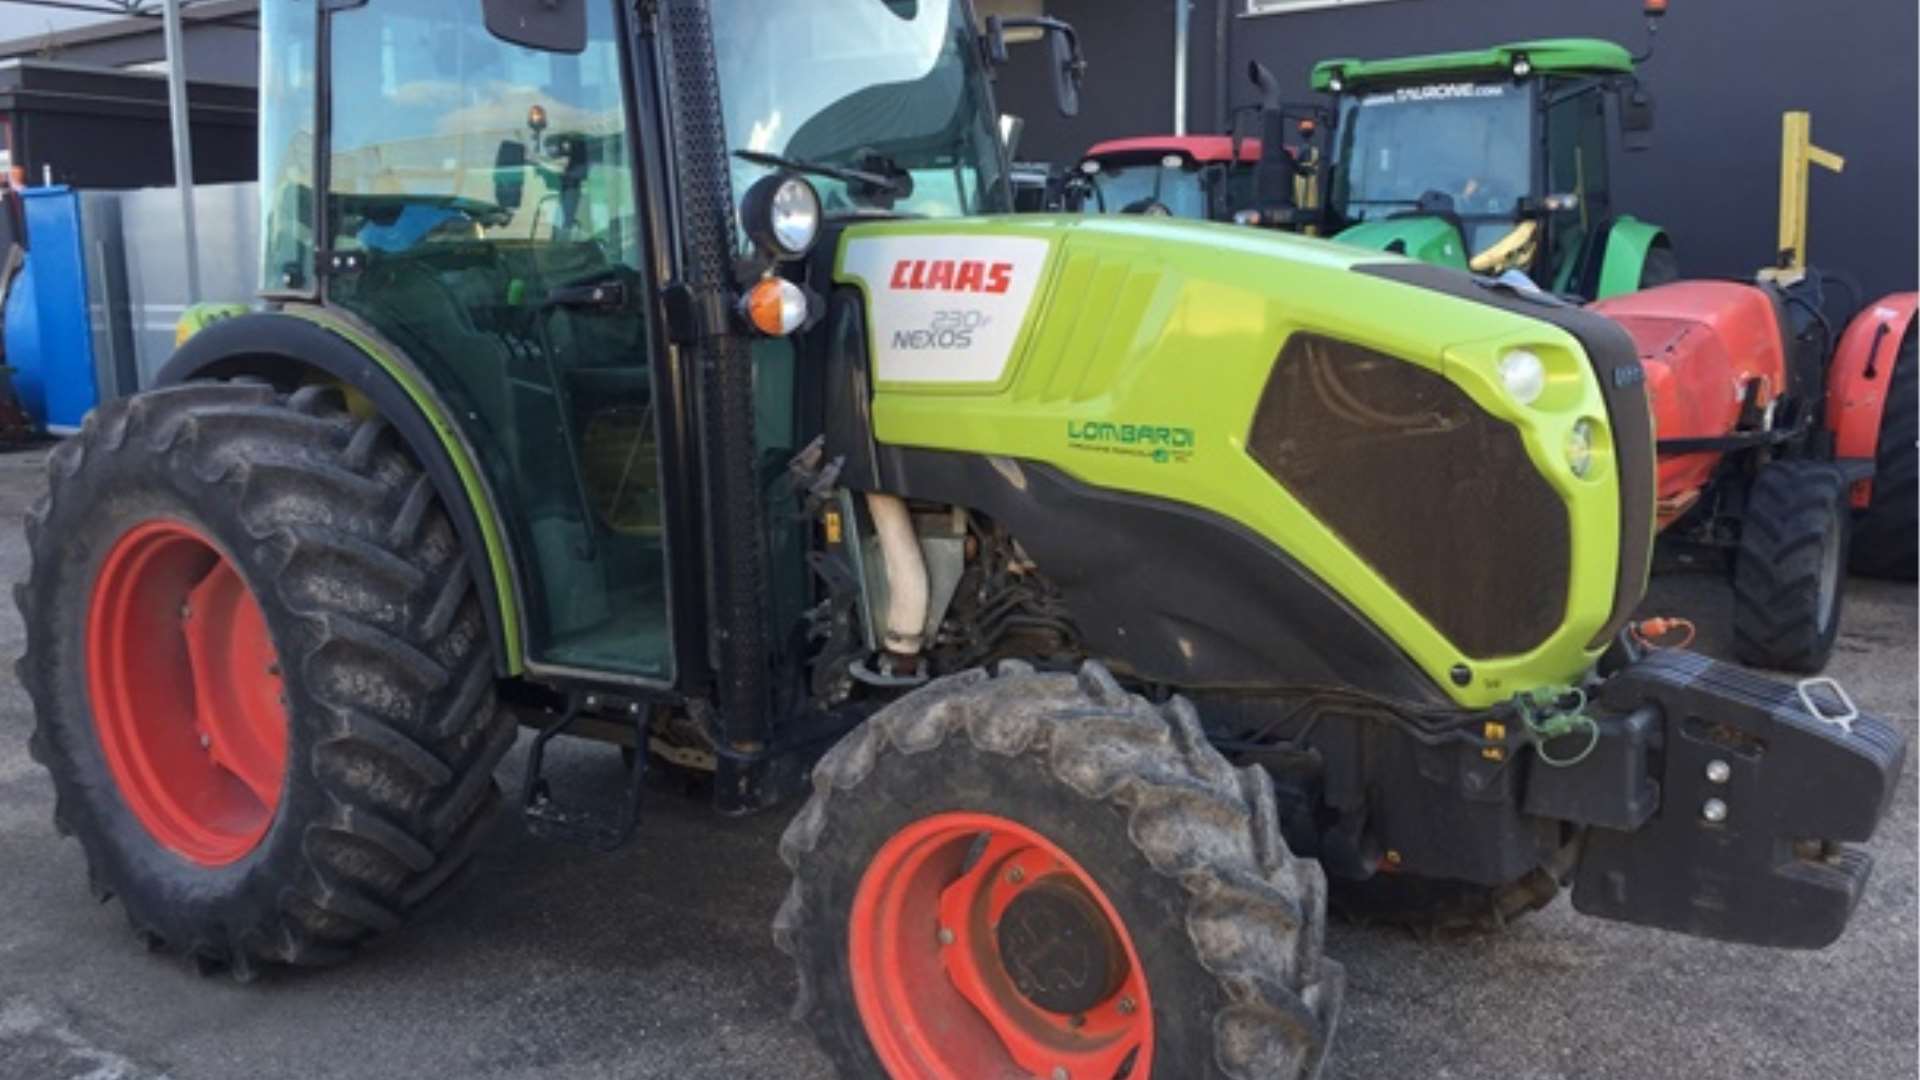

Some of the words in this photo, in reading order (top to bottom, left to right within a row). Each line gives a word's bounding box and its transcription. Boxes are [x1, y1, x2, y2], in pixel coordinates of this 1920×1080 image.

[890, 259, 1013, 294] CLAAS
[891, 329, 975, 350] NEXOS
[1067, 420, 1195, 446] LOMBARDI
